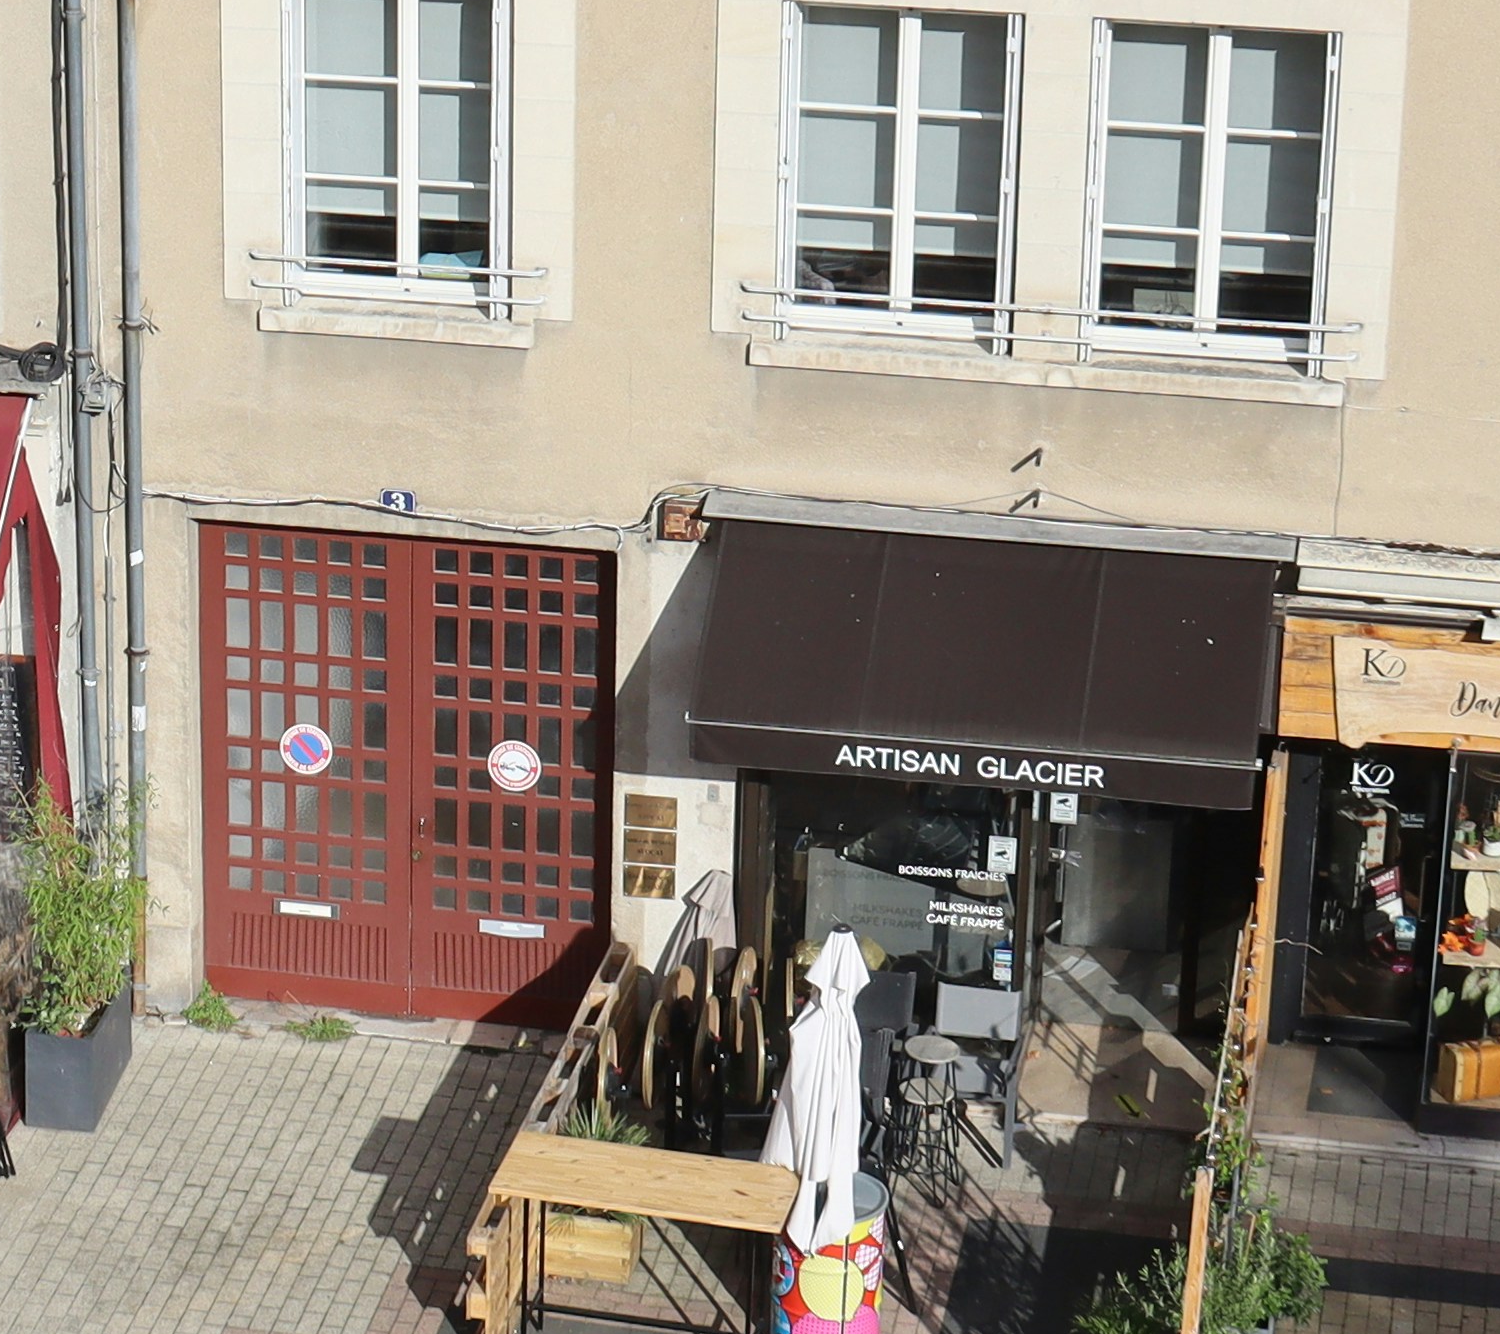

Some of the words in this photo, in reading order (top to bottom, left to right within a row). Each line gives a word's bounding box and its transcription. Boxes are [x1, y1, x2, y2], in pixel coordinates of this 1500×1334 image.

[390, 492, 406, 512] 3
[835, 744, 960, 776] ARTISAN
[976, 756, 1104, 788] GLACIER
[898, 864, 953, 879] BOISSONS
[929, 900, 1004, 917] MILKSHAKES
[925, 913, 958, 927] CAFÉ
[959, 916, 1005, 931] FRAPPÉ
